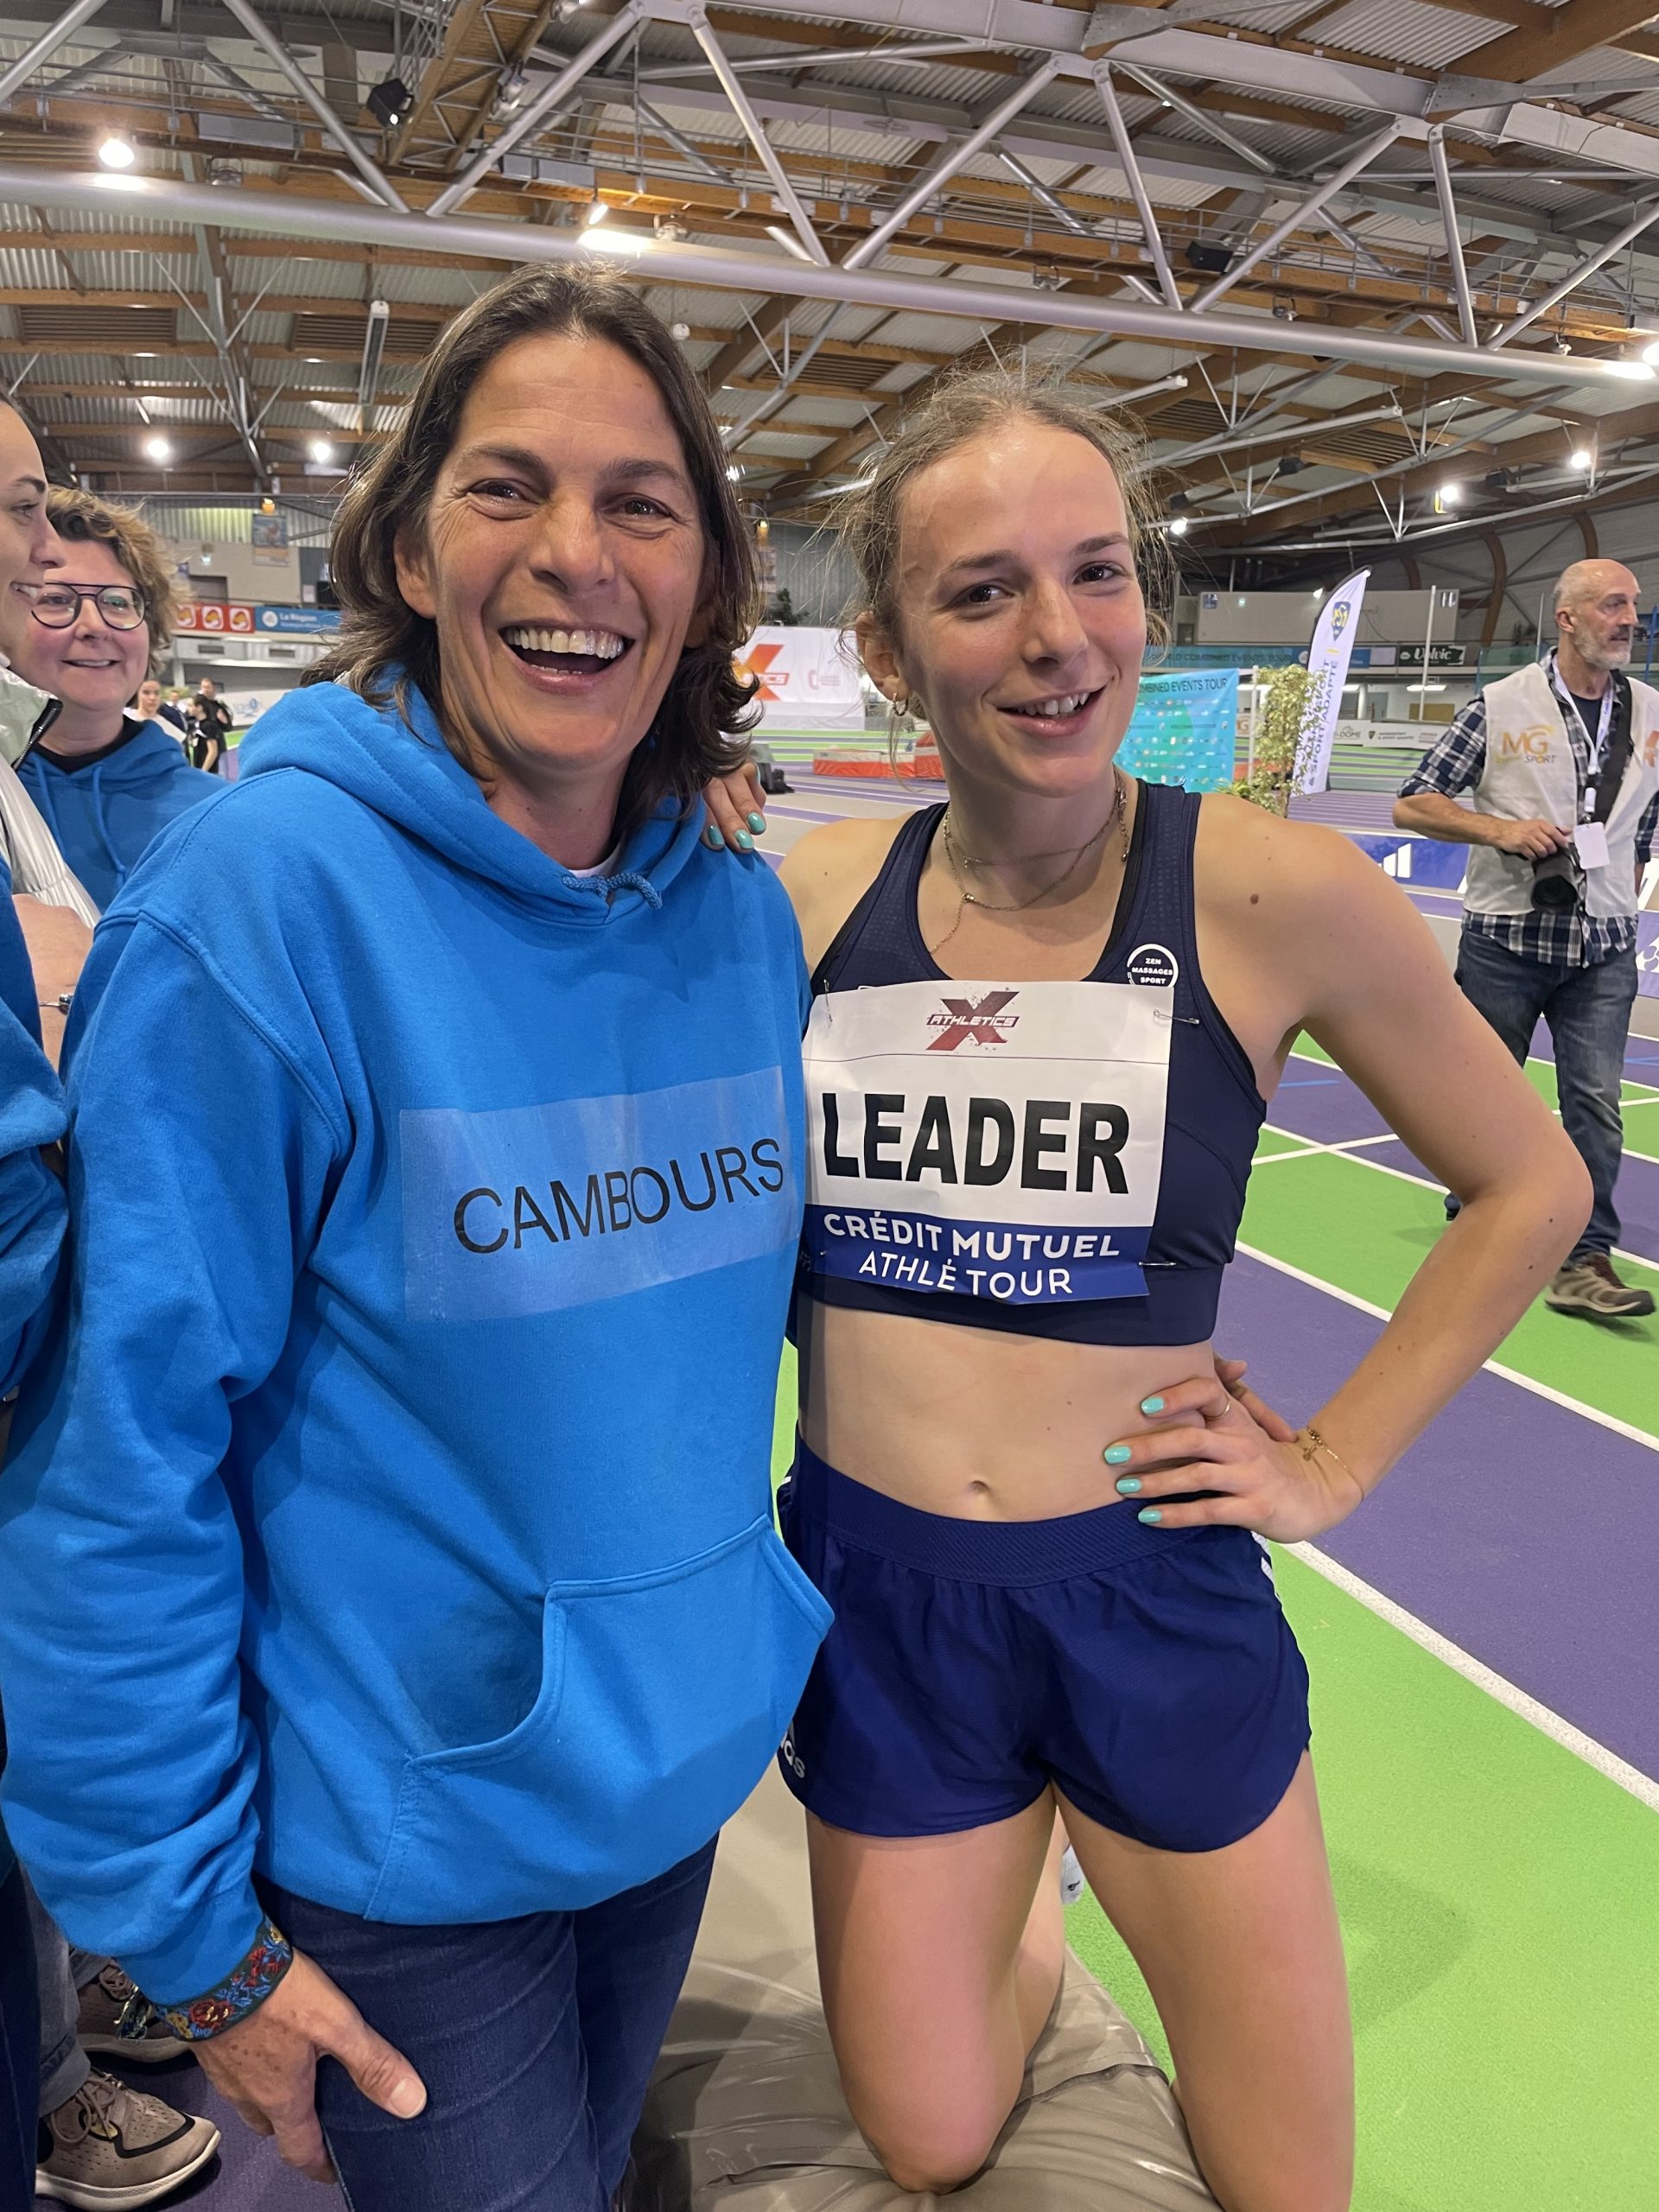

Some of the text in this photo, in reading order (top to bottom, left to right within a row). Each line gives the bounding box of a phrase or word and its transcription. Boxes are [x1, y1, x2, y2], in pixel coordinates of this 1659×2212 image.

[1414, 647, 1452, 660] Vlvic
[1171, 679, 1203, 692] EVENTS
[1205, 677, 1228, 690] TOUR
[1501, 732, 1549, 754] MG
[1524, 754, 1557, 764] SPORT
[1131, 967, 1173, 976] MASSAGES
[1140, 976, 1166, 985] SPORT
[930, 1014, 1017, 1027] ATHLETICS
[822, 1092, 1129, 1195] LEADER
[454, 1138, 784, 1254] CAMBOURS
[823, 1211, 1120, 1262] CRÉDIT MUTUEL
[858, 1250, 1073, 1299] ATHLÉ TOUR
